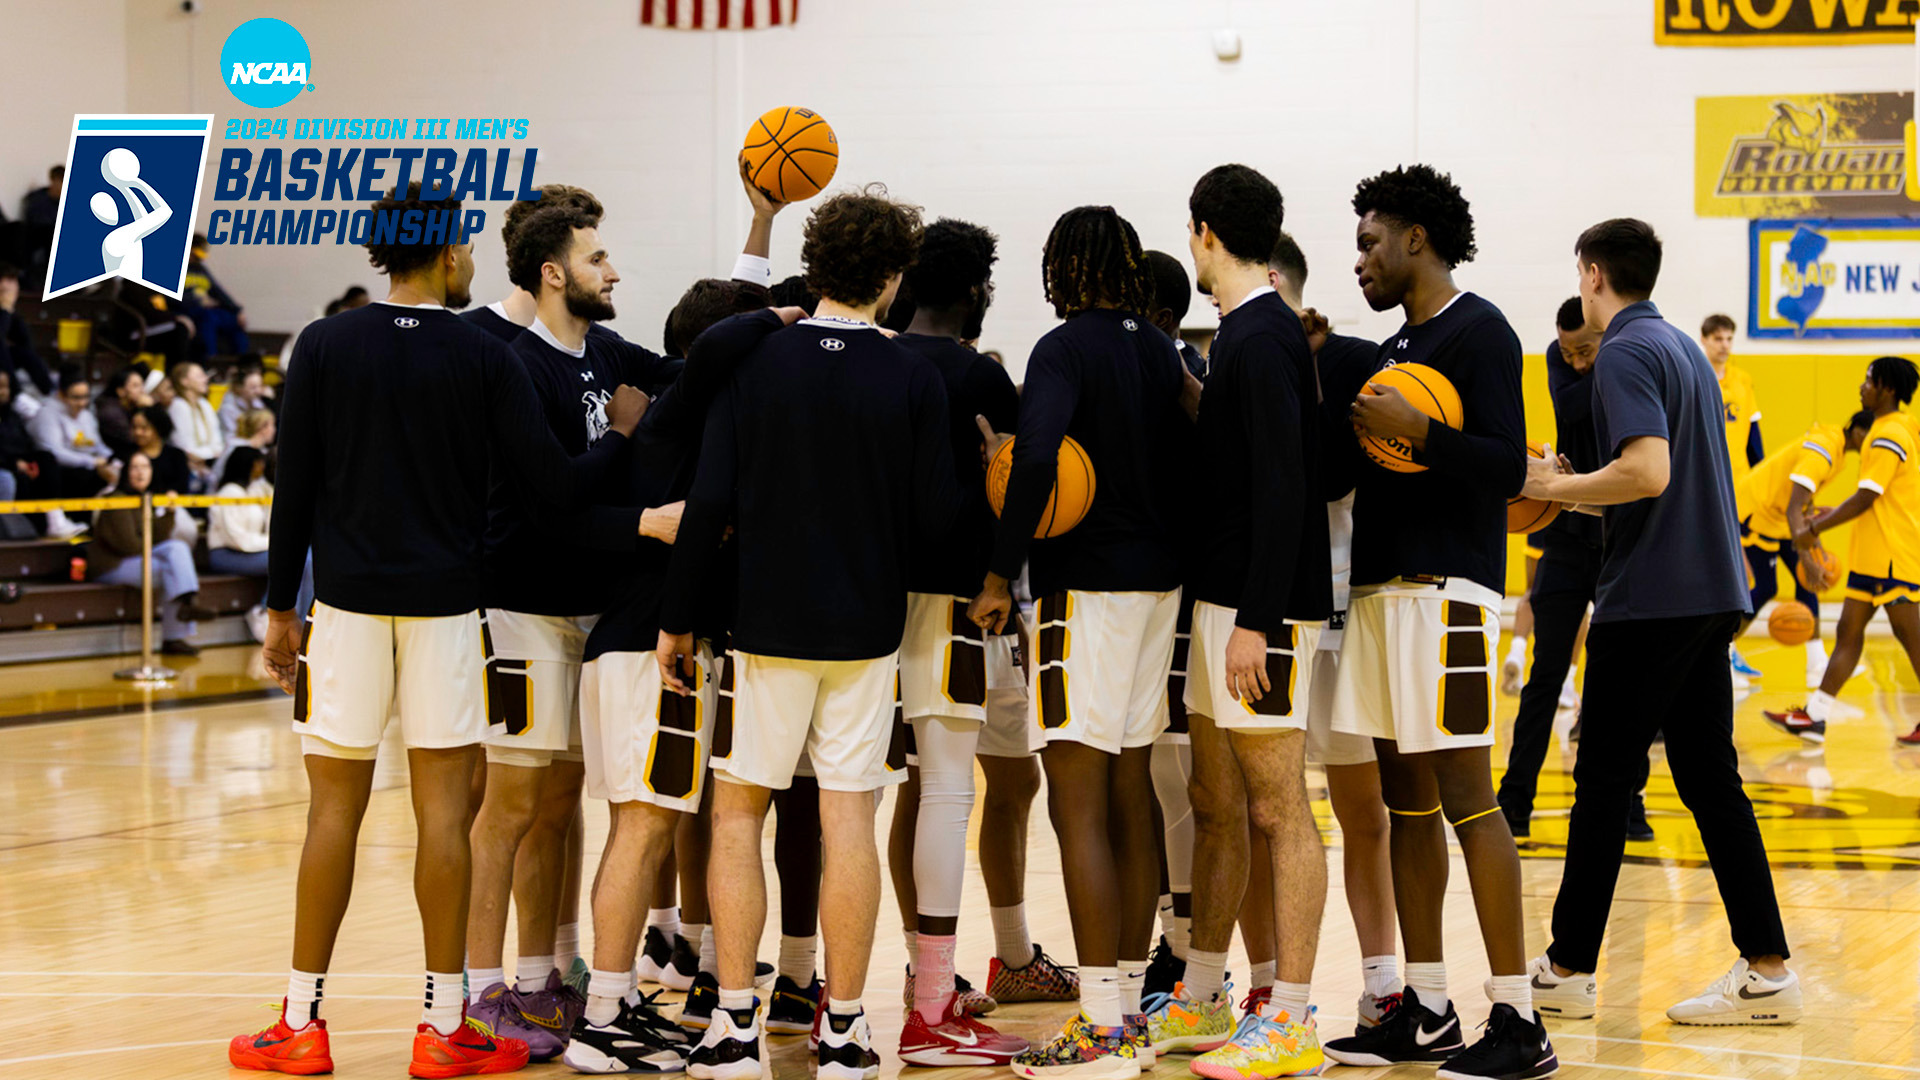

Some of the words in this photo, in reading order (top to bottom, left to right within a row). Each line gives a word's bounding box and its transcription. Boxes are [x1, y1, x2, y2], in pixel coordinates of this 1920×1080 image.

[1727, 141, 1906, 178] Rowan
[1721, 174, 1899, 192] VOLLEYBALL
[1846, 264, 1900, 293] NEW
